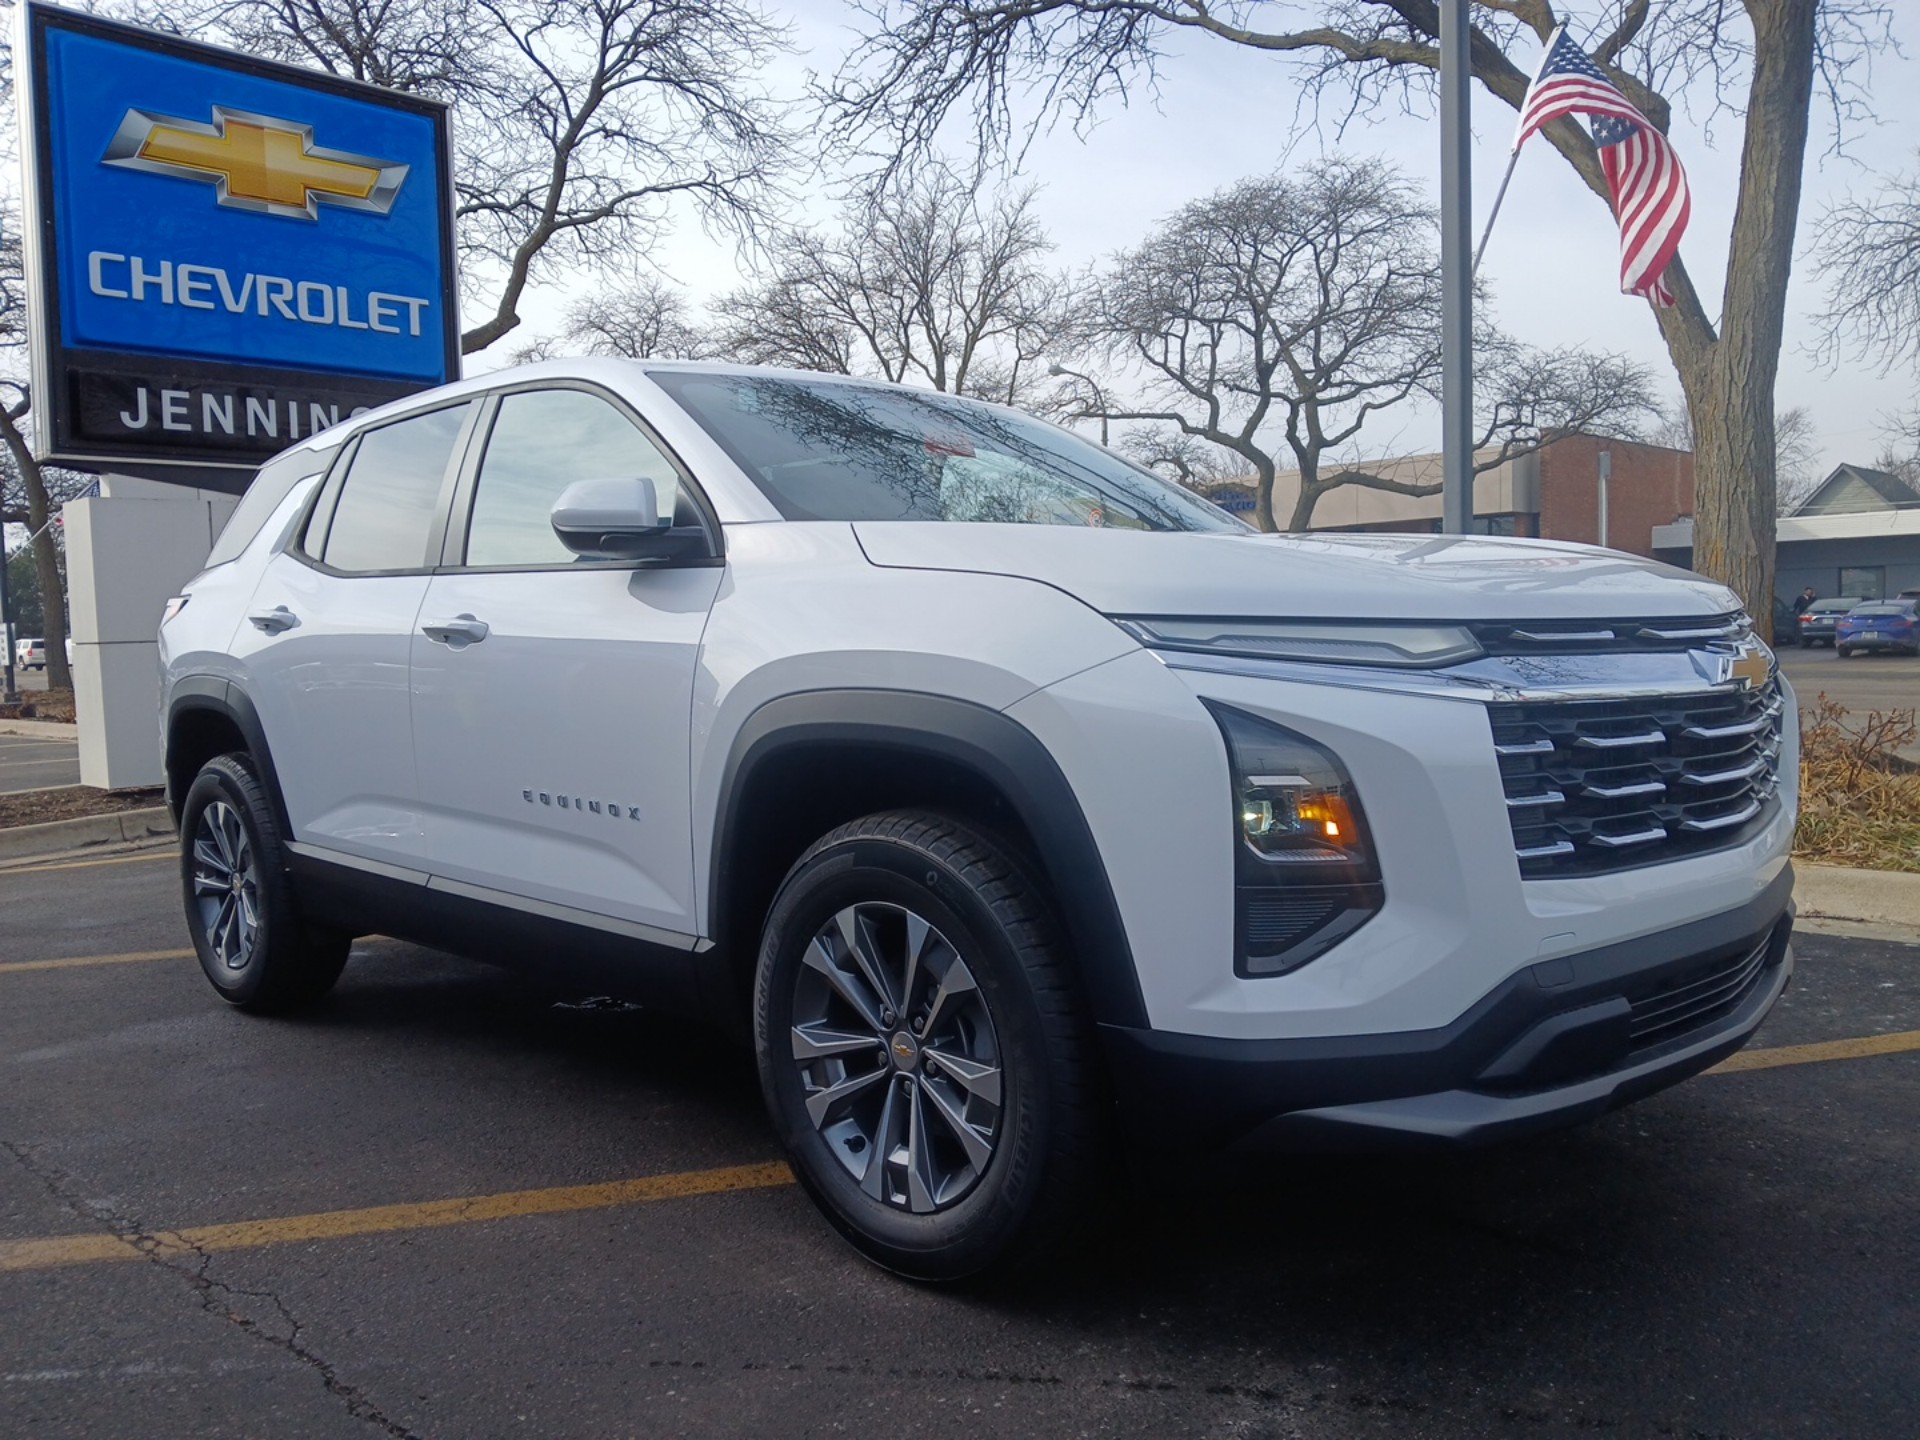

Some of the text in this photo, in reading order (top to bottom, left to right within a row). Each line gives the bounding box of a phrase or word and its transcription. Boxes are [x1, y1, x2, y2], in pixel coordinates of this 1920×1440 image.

[88, 250, 429, 336] CHEVROLET
[119, 387, 372, 439] JENNIN
[522, 788, 641, 822] EQUINOX
[757, 935, 779, 1042] MICHELIN
